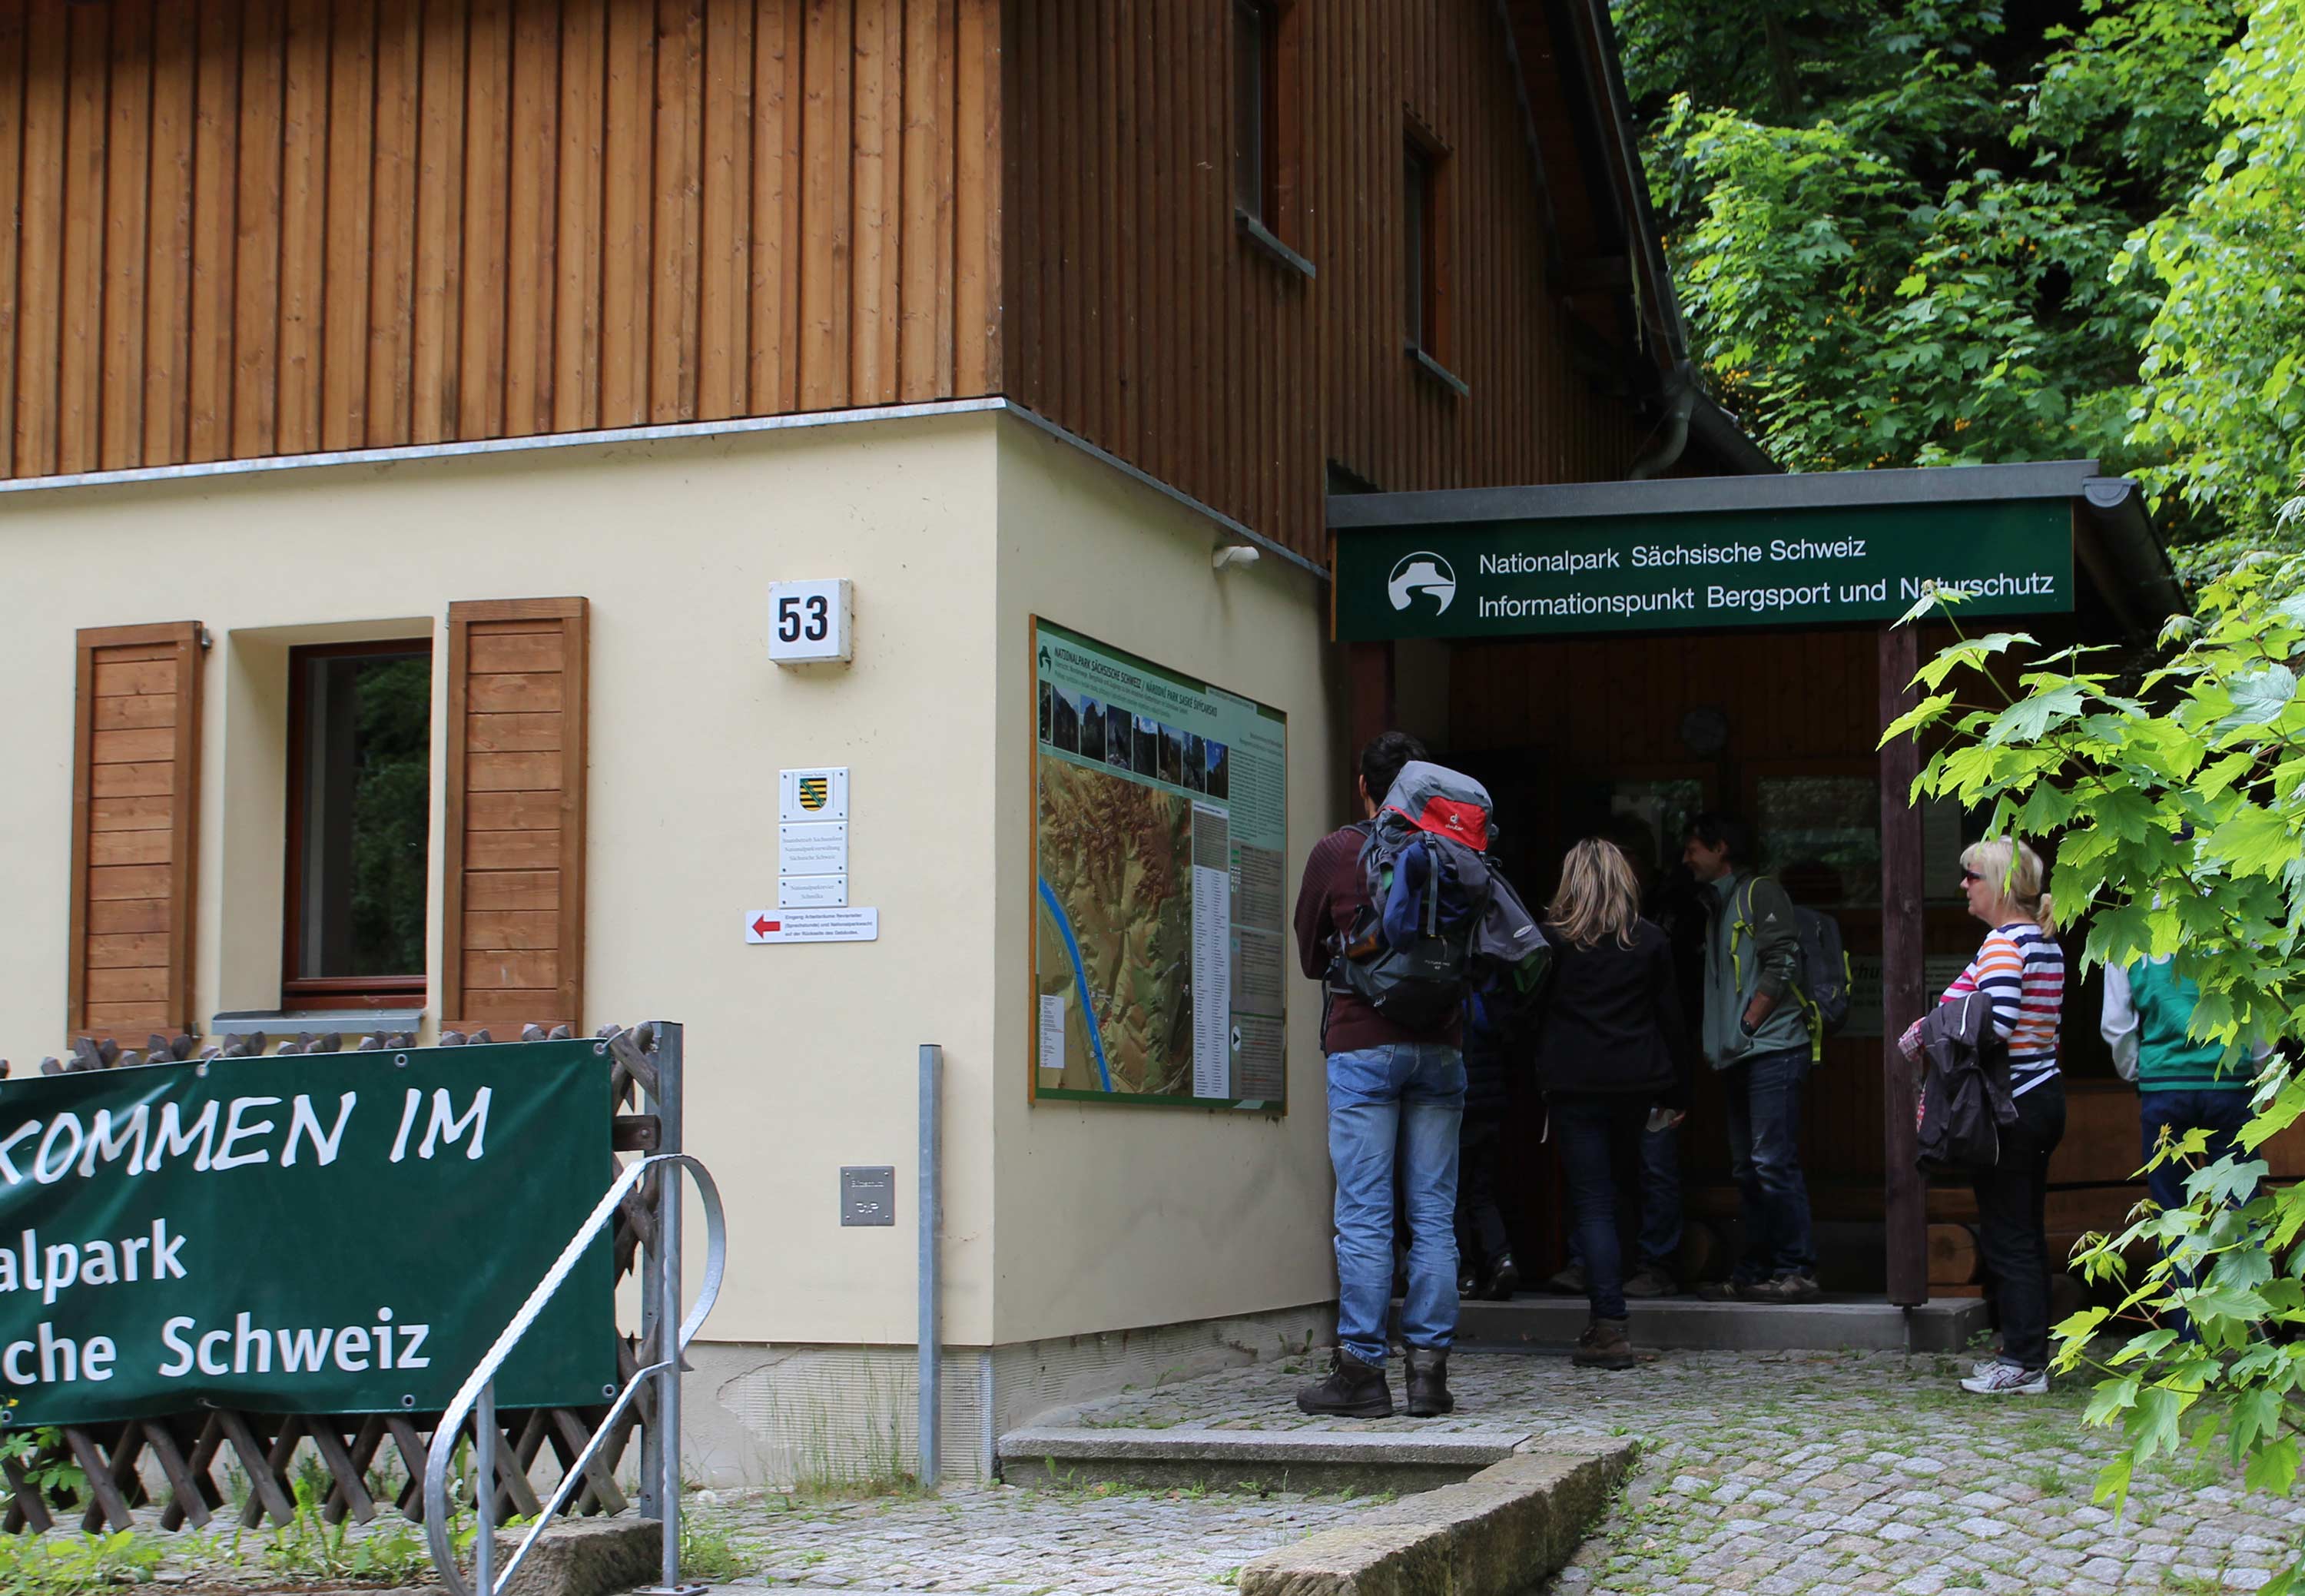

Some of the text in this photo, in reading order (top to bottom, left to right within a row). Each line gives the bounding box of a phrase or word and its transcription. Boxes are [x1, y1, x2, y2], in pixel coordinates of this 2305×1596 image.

[1479, 536, 1866, 575] Nationalpark Sächsische Schweiz
[778, 596, 827, 642] 53
[1479, 588, 1695, 618] Informationspunkt
[1707, 582, 1831, 612] Bergsport
[1839, 579, 1886, 603] und
[1055, 646, 1091, 669] NATIONALPARK
[1091, 659, 1121, 682] SÄCHSISCHE
[1120, 671, 1142, 689] SCHWEIZ
[1166, 689, 1179, 702] PARK
[390, 1086, 492, 1163] IM
[2, 1306, 430, 1385] che Schweiz
